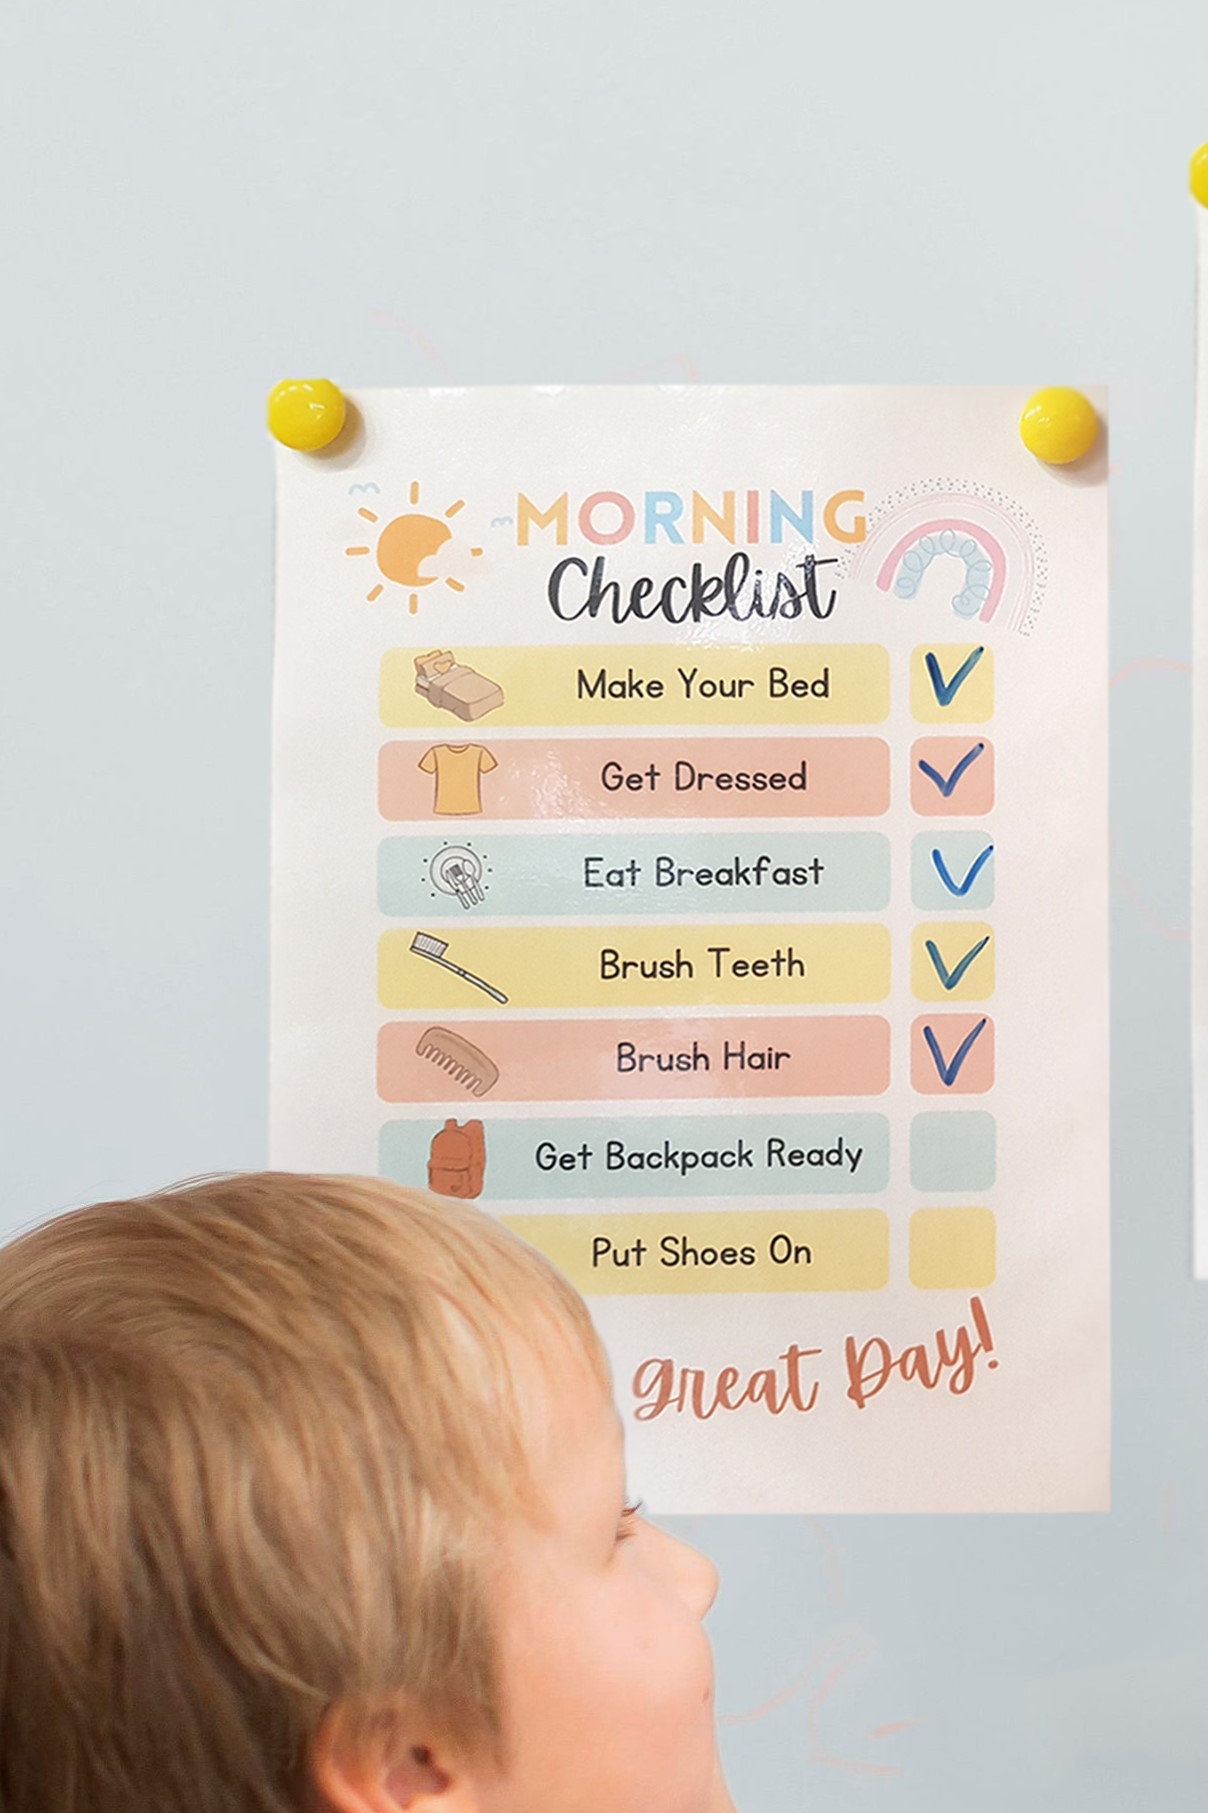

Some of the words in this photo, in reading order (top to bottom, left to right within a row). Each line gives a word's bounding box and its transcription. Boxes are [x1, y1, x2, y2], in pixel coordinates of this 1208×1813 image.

[517, 490, 866, 547] MORNING
[547, 552, 838, 624] Checklist
[577, 668, 665, 700] Make
[677, 668, 755, 699] Your
[767, 668, 829, 699] Bed
[601, 761, 661, 792] Get
[675, 760, 807, 791] Dressed
[584, 856, 641, 887] Eat
[654, 855, 825, 887] Breakfast
[600, 950, 693, 979] Brush
[708, 948, 805, 979] Teeth
[616, 1042, 709, 1073] Brush
[724, 1041, 791, 1071] Hair
[536, 1141, 593, 1172] Get
[605, 1139, 753, 1176] Backpack
[767, 1137, 863, 1173] Ready
[593, 1237, 647, 1267] Put
[660, 1235, 756, 1266] Shoes
[769, 1233, 812, 1265] On
[632, 1344, 823, 1422] great
[843, 1297, 999, 1411] Day!
